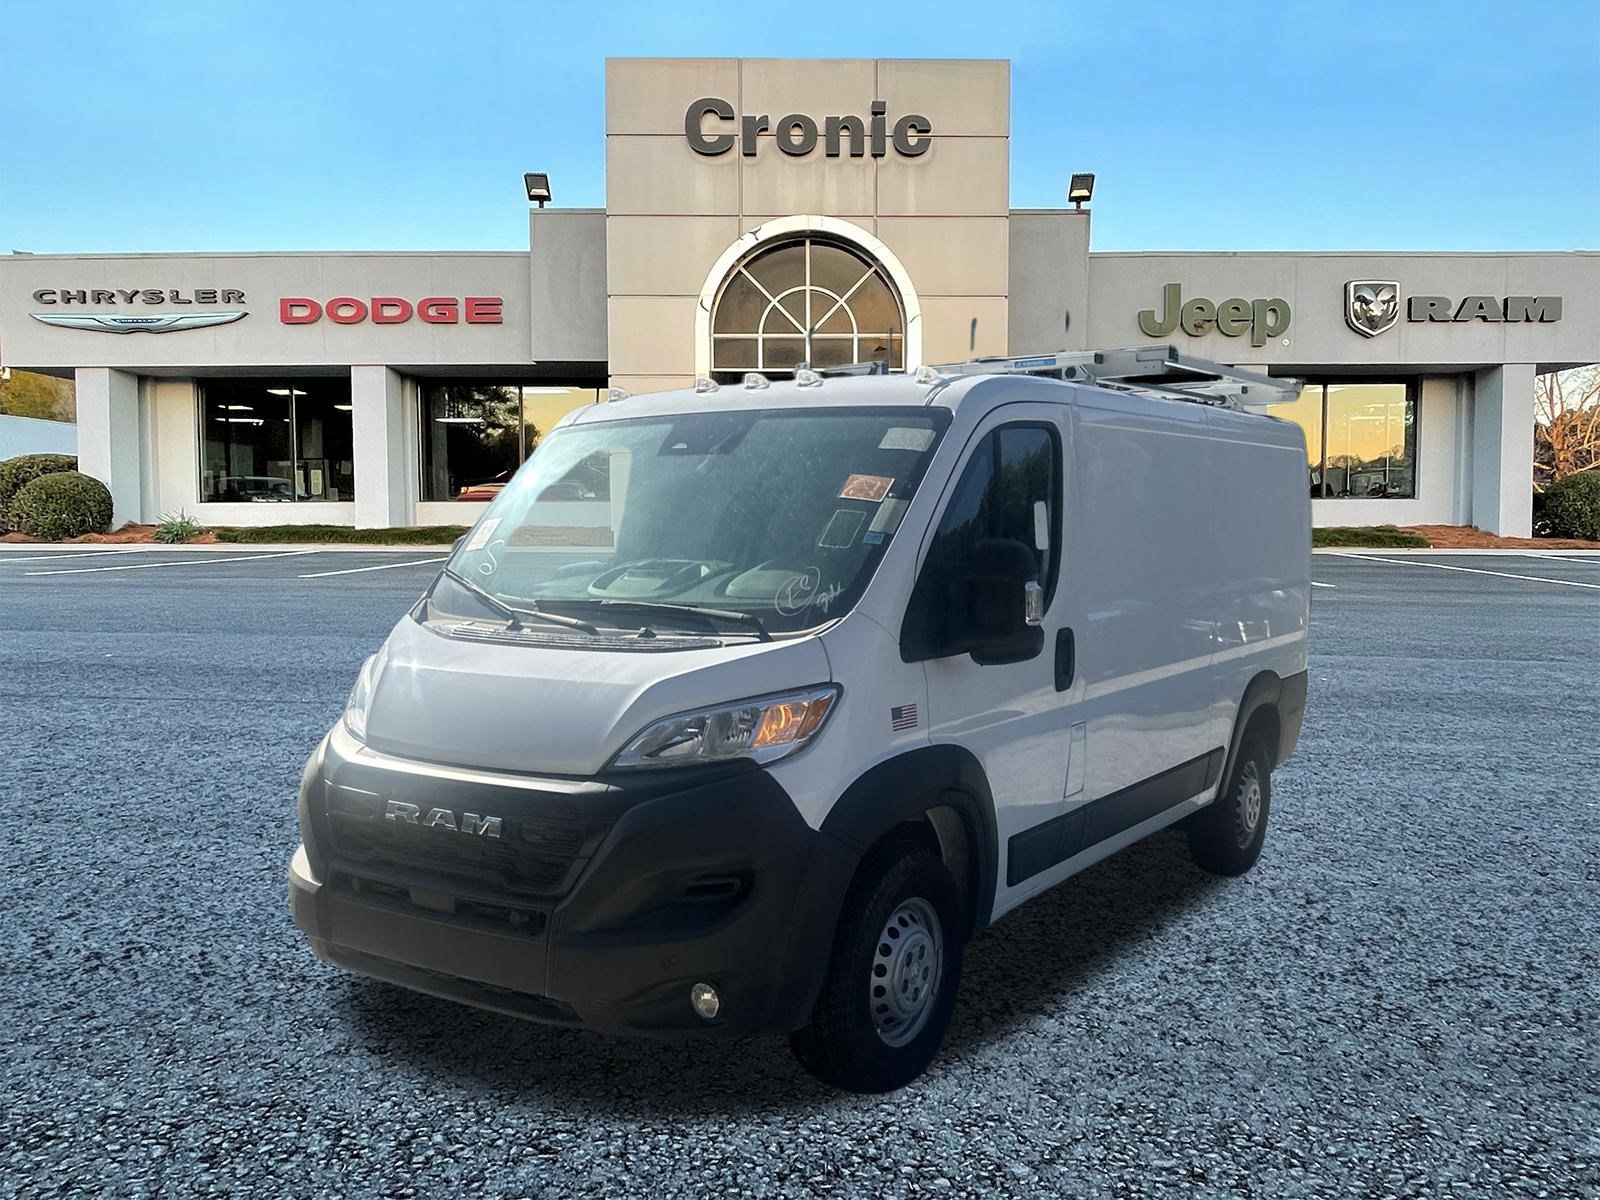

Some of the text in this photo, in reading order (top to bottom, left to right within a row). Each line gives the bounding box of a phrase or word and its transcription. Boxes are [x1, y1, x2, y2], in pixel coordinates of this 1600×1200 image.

[684, 97, 932, 157] Cronic
[32, 289, 246, 305] CHRYSLER
[280, 297, 503, 324] DODGE
[1407, 296, 1563, 323] RAM
[1138, 283, 1292, 347] Jeep
[385, 800, 502, 838] RAM
